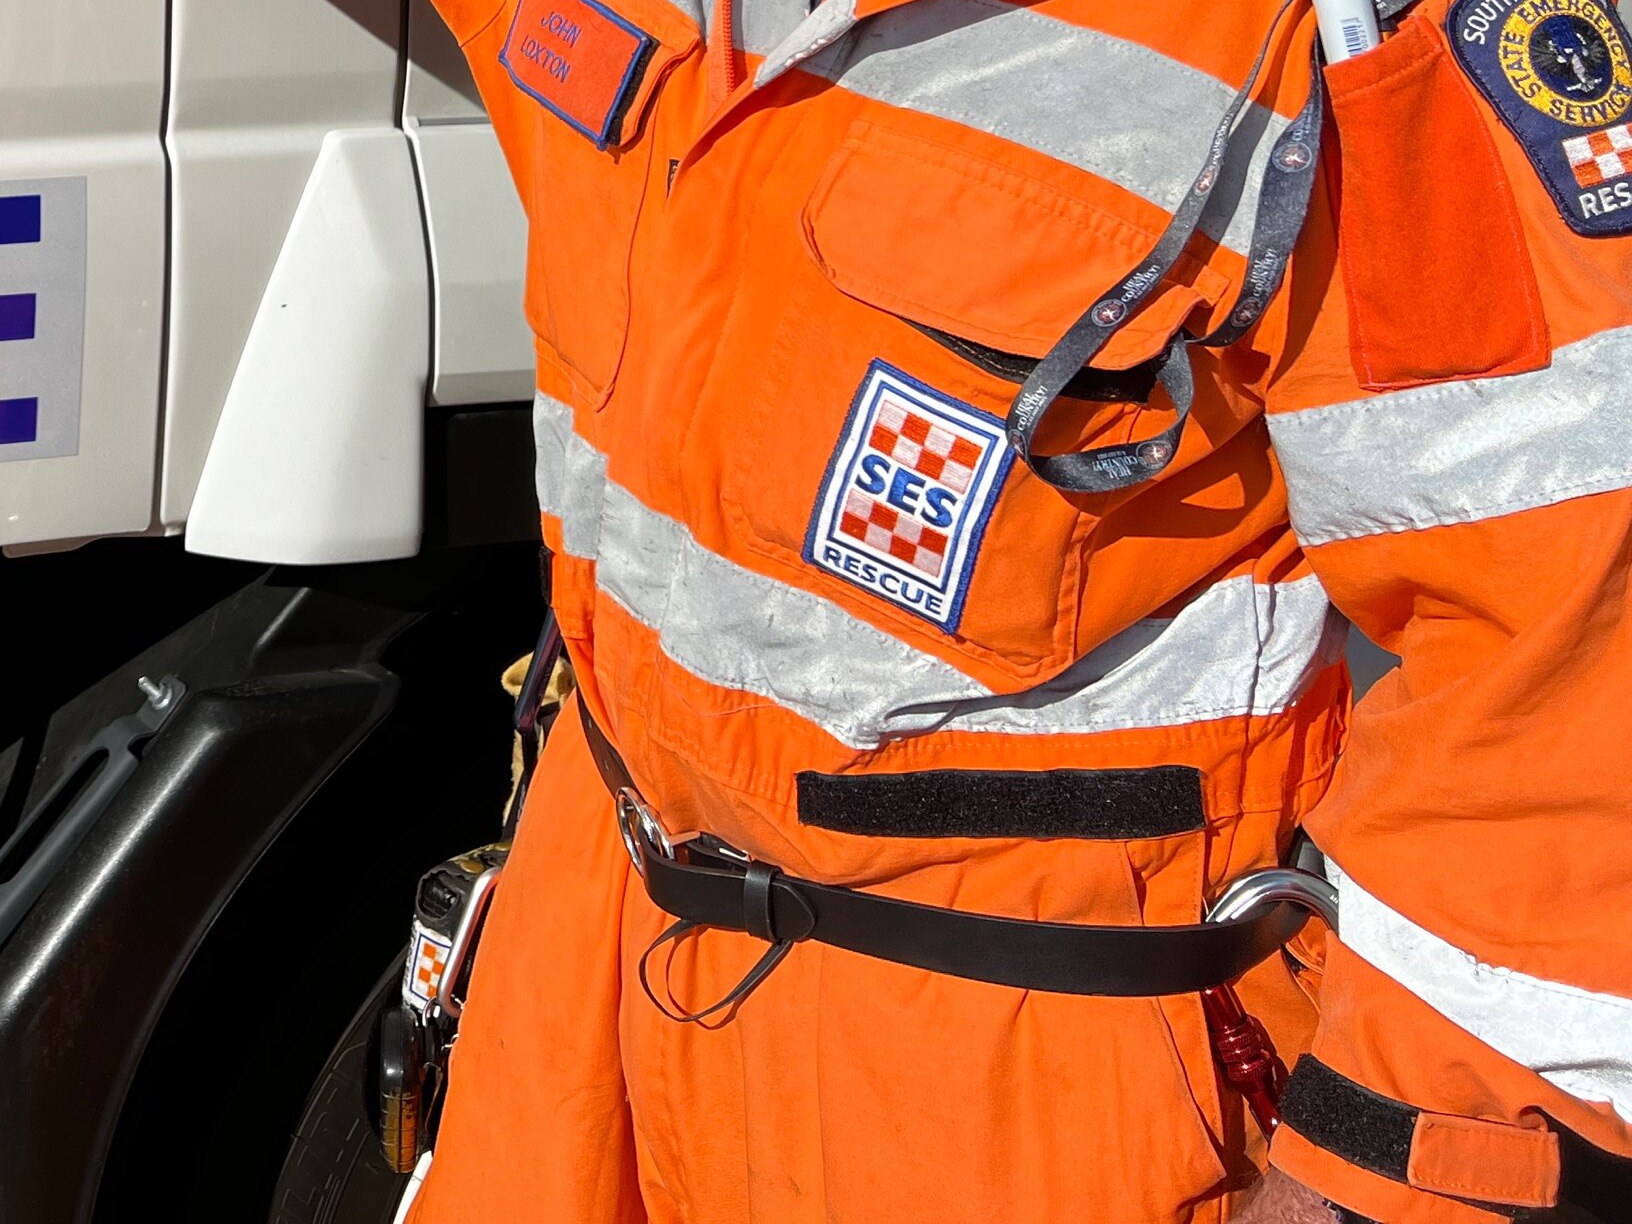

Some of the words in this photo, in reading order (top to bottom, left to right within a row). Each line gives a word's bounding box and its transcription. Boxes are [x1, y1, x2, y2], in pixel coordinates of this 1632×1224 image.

[520, 33, 572, 84] LOXTON
[540, 10, 582, 49] JOHN
[1502, 30, 1542, 99] STATE
[855, 454, 958, 528] SES
[822, 545, 943, 615] RESCUE
